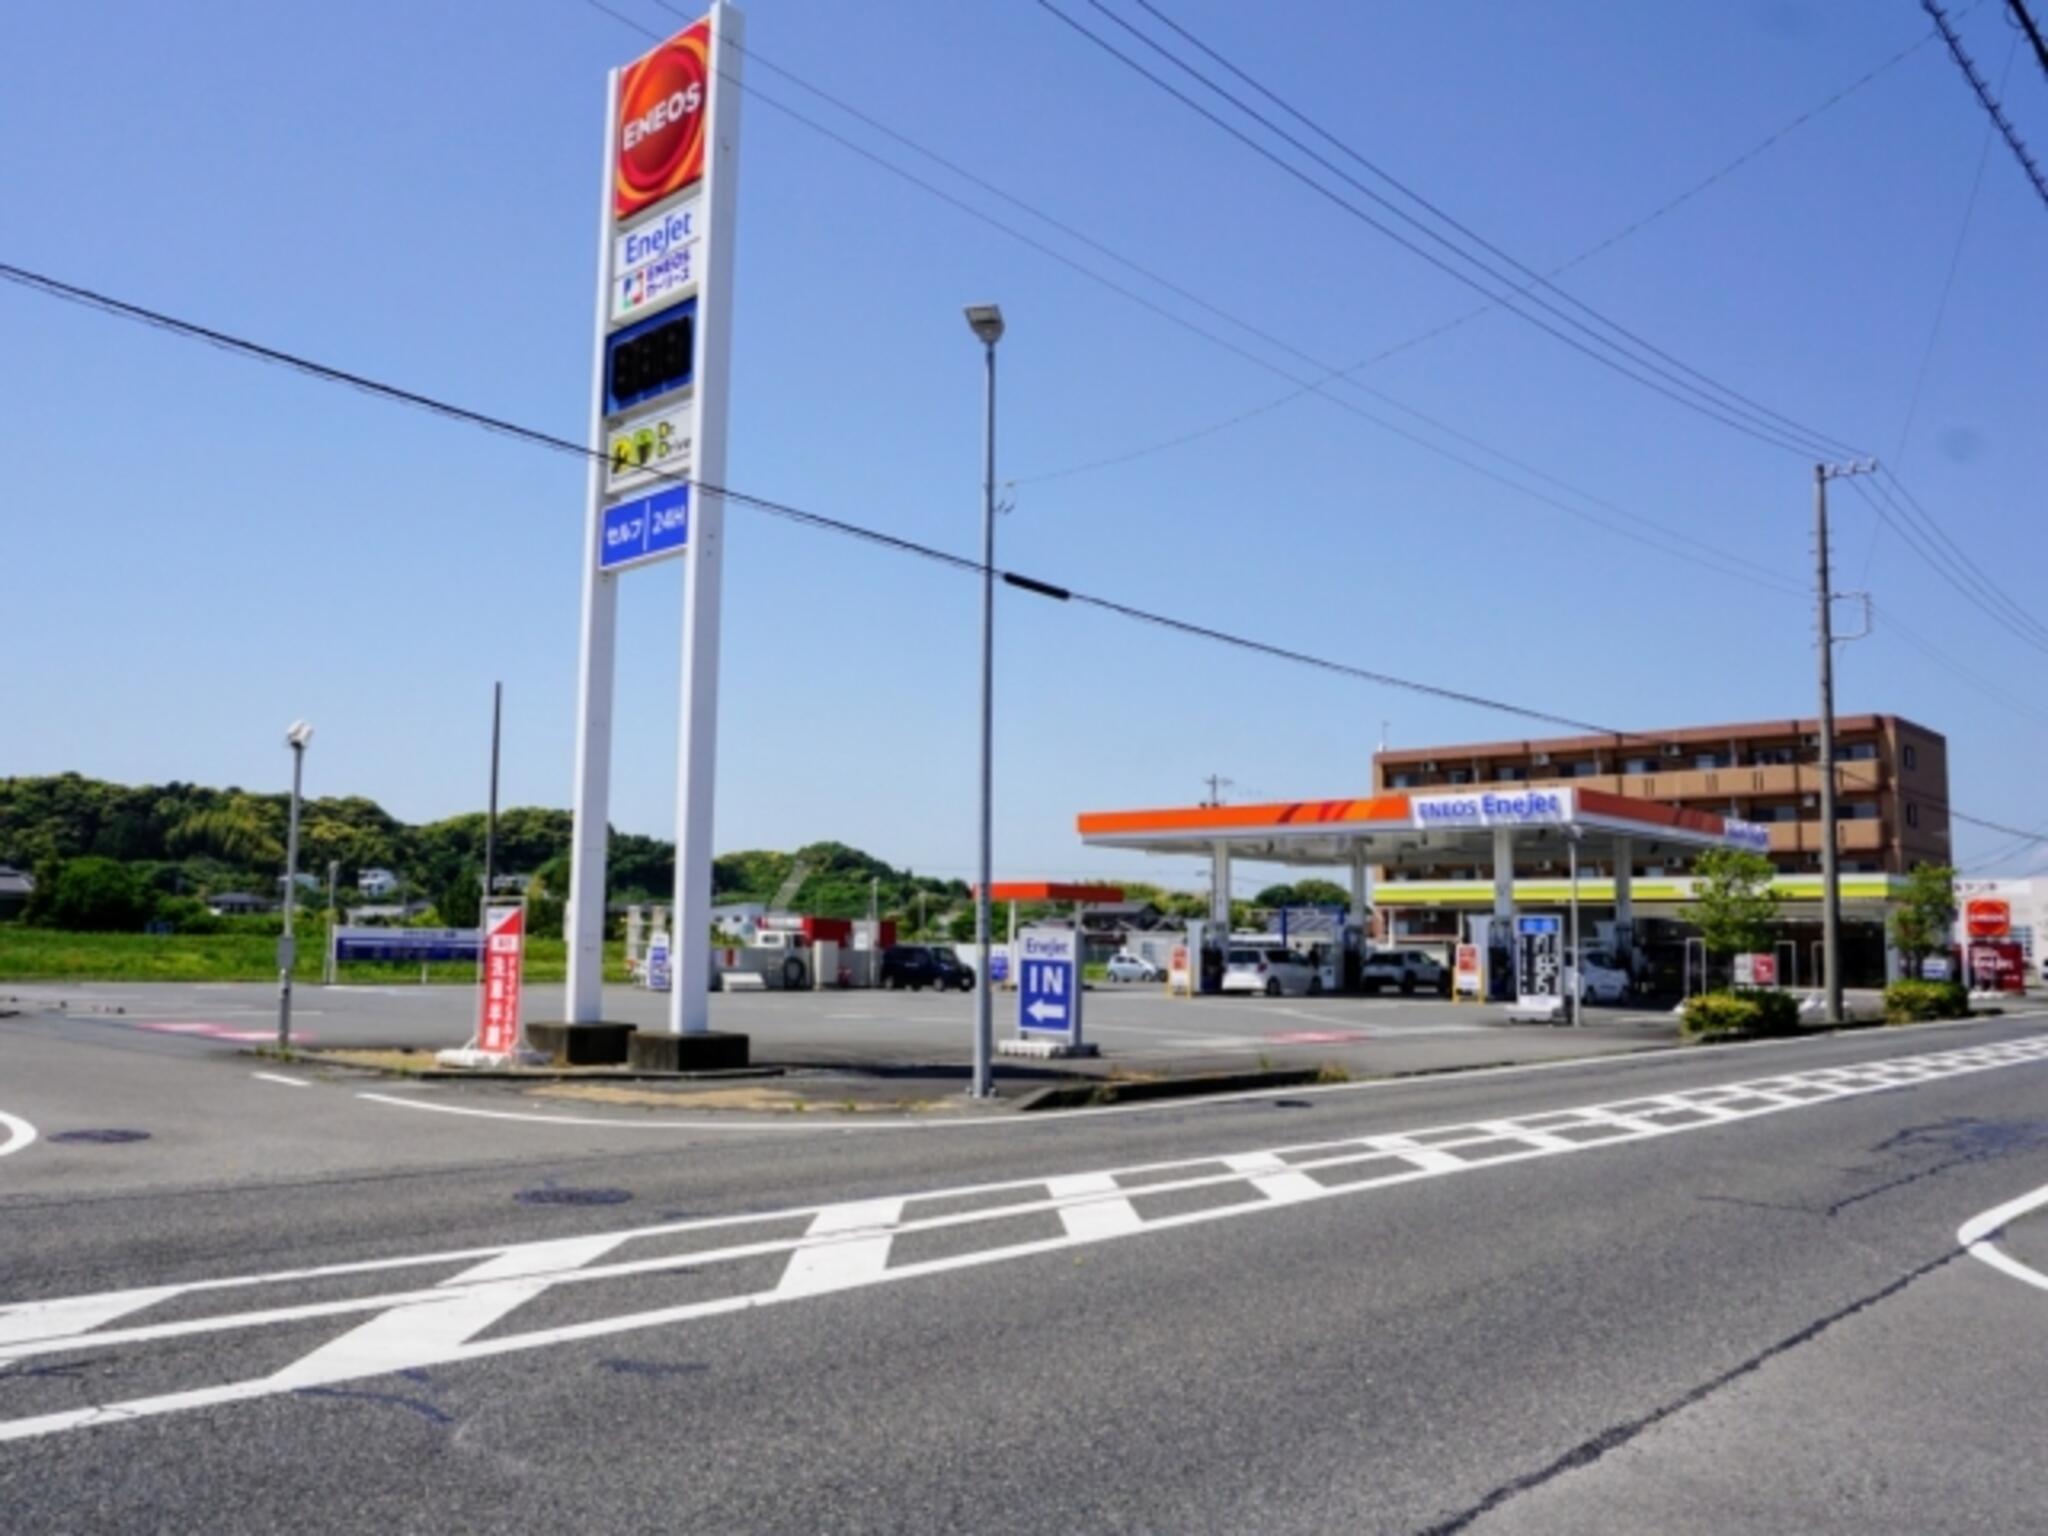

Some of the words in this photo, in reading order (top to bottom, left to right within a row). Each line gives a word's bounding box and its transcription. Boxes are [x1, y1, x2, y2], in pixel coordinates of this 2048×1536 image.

[623, 82, 700, 151] ENEOS
[625, 212, 692, 265] Enejet
[607, 518, 643, 546] セルフ
[1418, 800, 1477, 819] ENEOS
[1482, 793, 1560, 819] Enejet
[1029, 965, 1064, 995] IN
